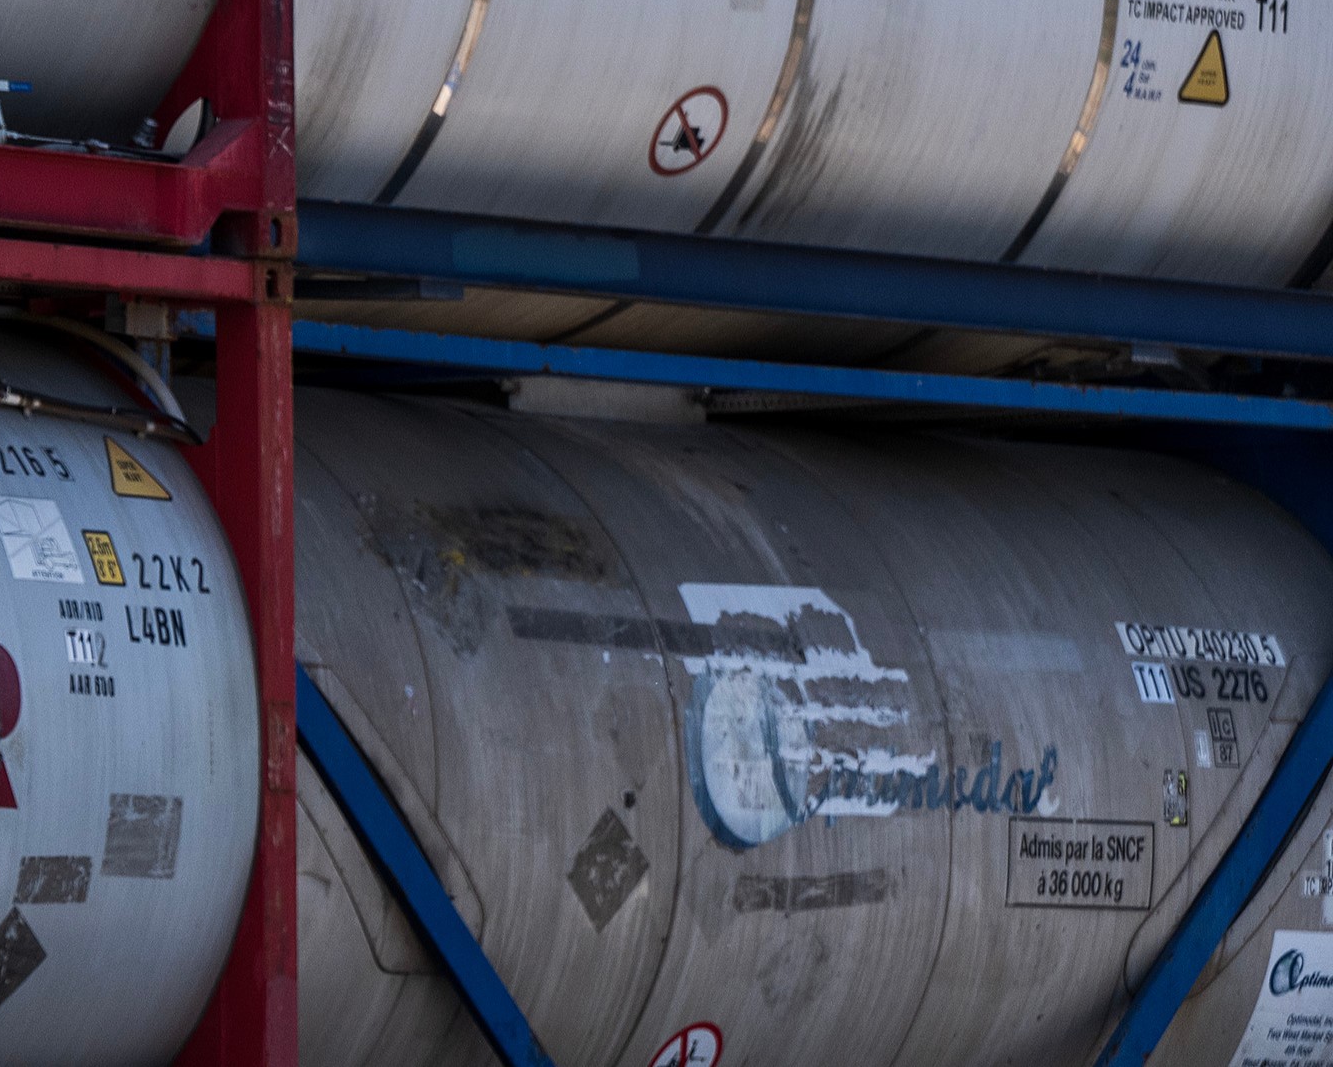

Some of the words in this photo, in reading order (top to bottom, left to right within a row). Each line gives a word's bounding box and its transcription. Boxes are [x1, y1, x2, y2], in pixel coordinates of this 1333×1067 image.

[1128, 0, 1141, 18] TC
[1144, 2, 1184, 23] IMPACT
[1185, 7, 1245, 30] APPROVED
[1121, 39, 1141, 68] 24
[1124, 71, 1135, 99] 4
[132, 554, 211, 594] 22K2
[59, 599, 103, 622] ADR/RID
[125, 605, 186, 647] L4BN
[1126, 624, 1186, 656] OPTU
[1188, 629, 1259, 663] 240230
[1262, 636, 1276, 665] 5
[70, 674, 91, 695] AAR
[1135, 665, 1172, 700] T11
[1172, 665, 1205, 699] US
[1212, 667, 1268, 704] 2276
[1020, 833, 1062, 859] Admis
[1066, 840, 1088, 865] par
[1092, 835, 1103, 861] la
[1107, 836, 1144, 862] SNCF
[1049, 870, 1067, 896] 36
[1071, 871, 1101, 896] 000
